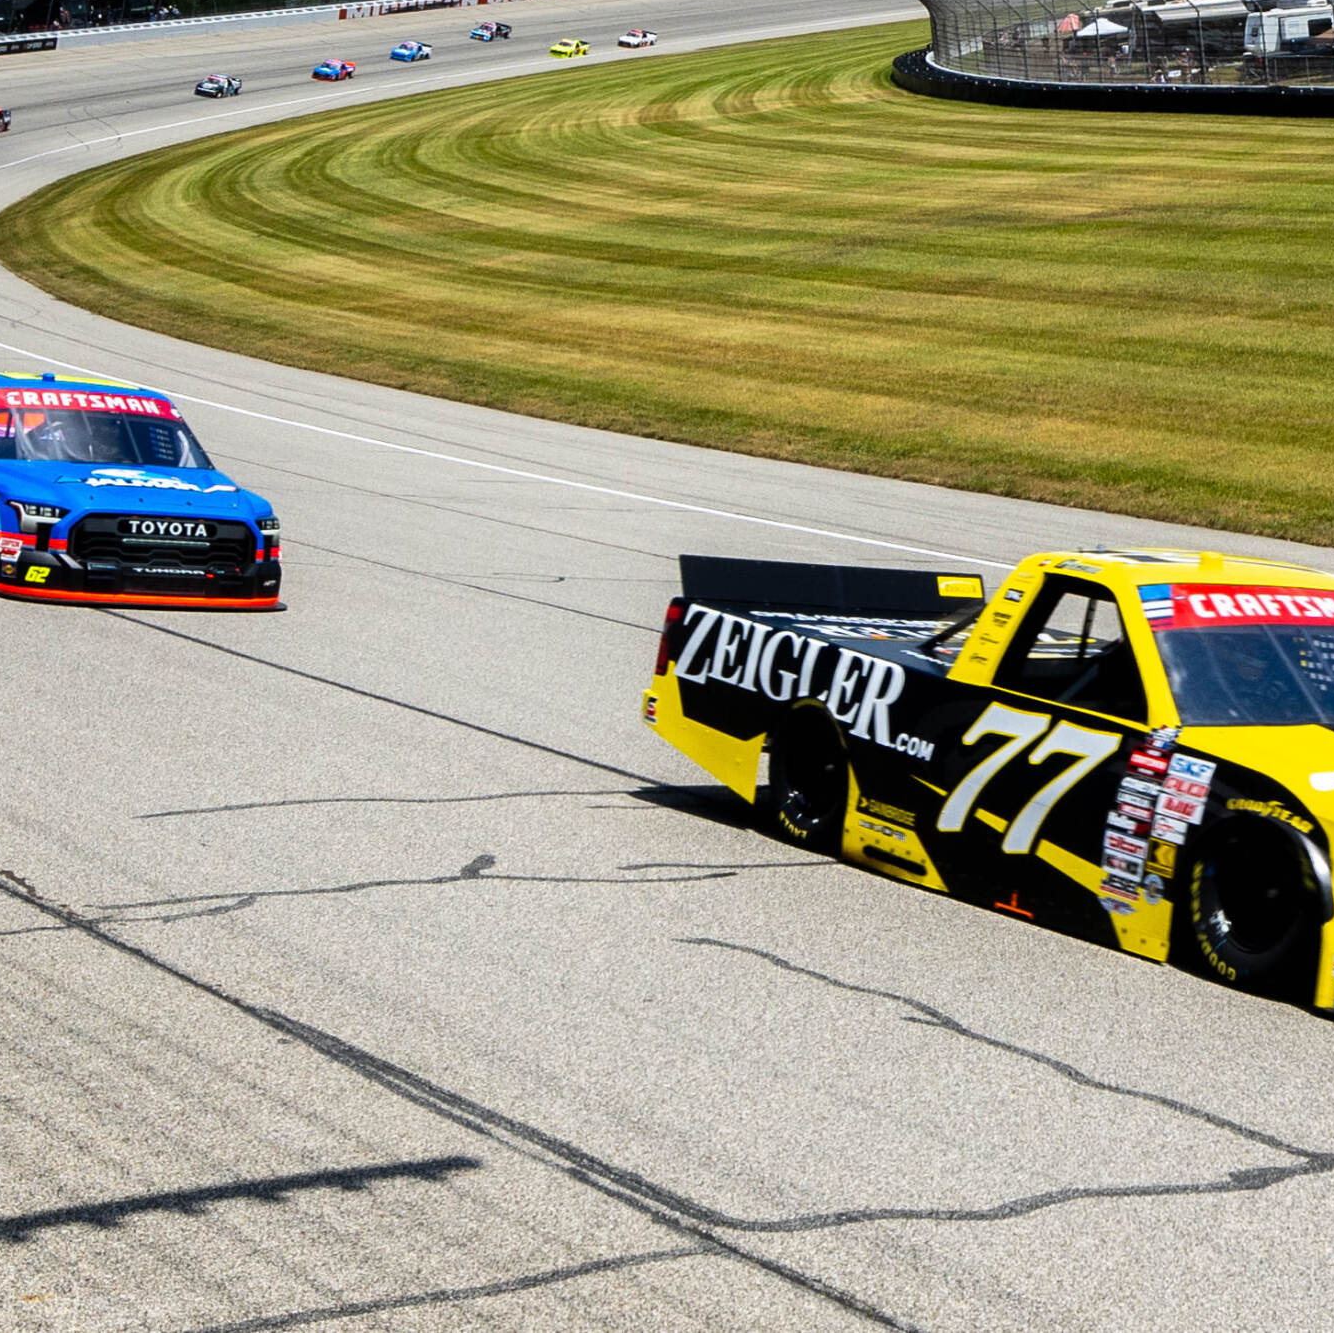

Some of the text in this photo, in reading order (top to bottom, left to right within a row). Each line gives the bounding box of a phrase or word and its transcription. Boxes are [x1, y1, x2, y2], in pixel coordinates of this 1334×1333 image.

[6, 391, 161, 415] CRAFTSMAN
[128, 520, 208, 537] TOYOTA
[24, 566, 52, 583] 62
[132, 566, 206, 576] TUNDRA
[937, 700, 1124, 855] 77
